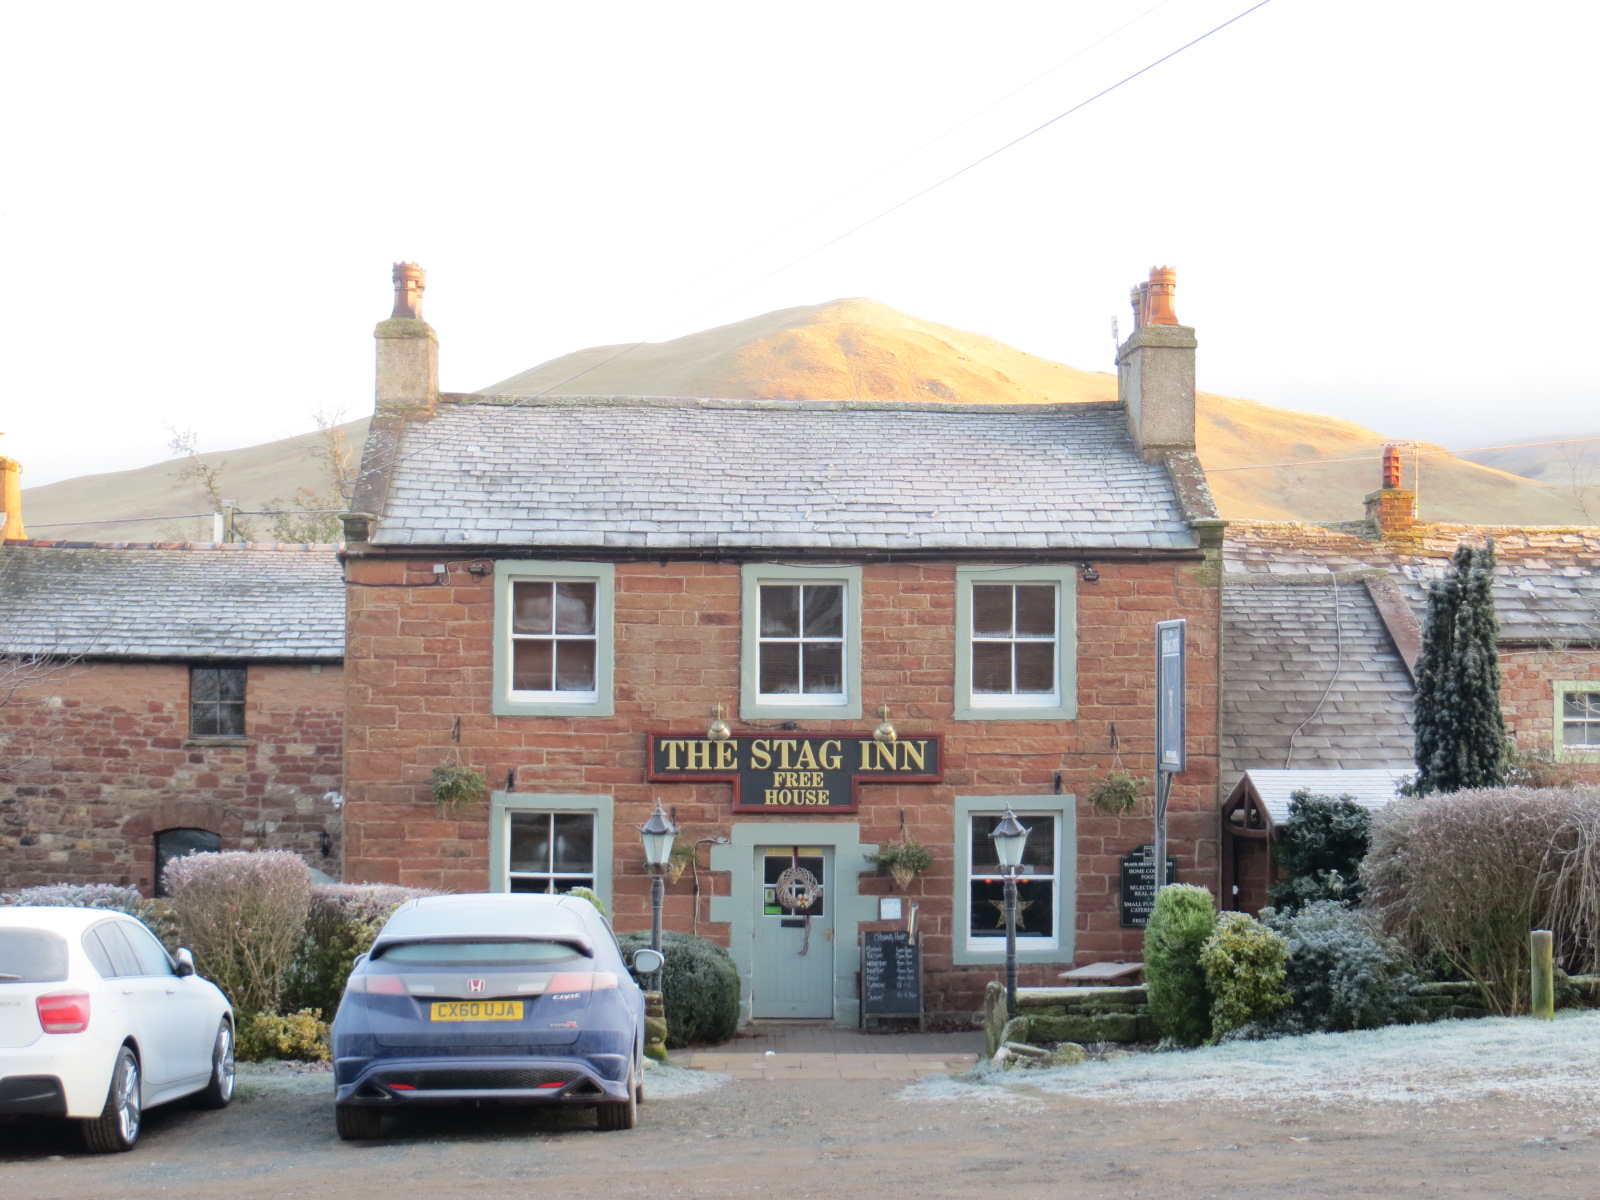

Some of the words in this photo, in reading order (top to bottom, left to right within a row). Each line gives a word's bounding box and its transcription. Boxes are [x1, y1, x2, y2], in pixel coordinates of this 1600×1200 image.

[661, 740, 738, 770] THE
[750, 739, 843, 770] STAG
[858, 740, 928, 770] INN
[773, 772, 824, 788] FREE
[764, 789, 830, 805] HOUSE
[438, 1003, 480, 1017] CX60
[484, 1002, 515, 1017] UJA
